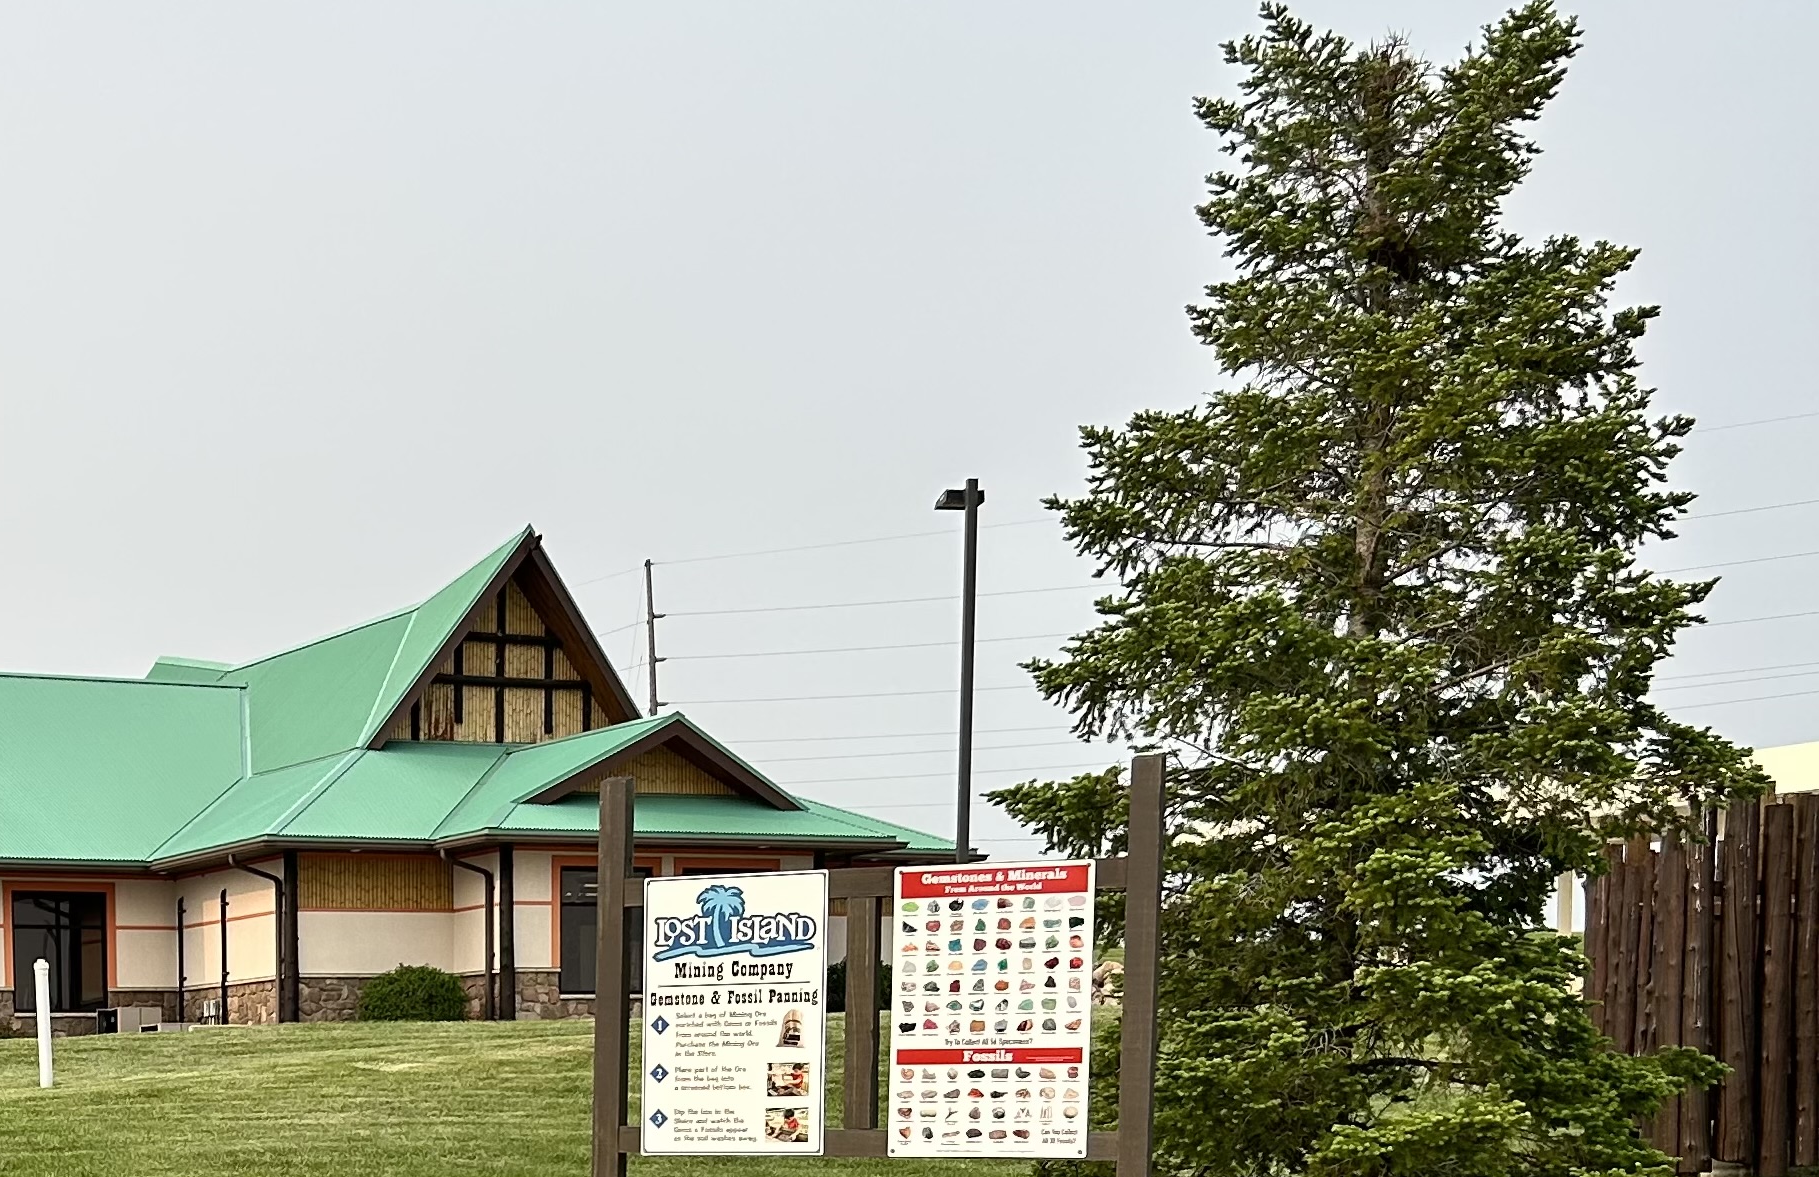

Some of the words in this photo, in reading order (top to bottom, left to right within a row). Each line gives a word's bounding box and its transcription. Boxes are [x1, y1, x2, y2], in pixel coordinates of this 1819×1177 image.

[922, 873, 992, 884] Gemstones
[995, 871, 1004, 881] &
[1008, 868, 1067, 881] Minerals
[968, 884, 999, 892] Around
[1016, 882, 1042, 890] World
[675, 961, 724, 981] Mining
[732, 961, 793, 980] Company
[651, 992, 705, 1006] Gemstone
[711, 991, 721, 1004] &
[728, 989, 762, 1004] Fossil
[769, 988, 818, 1005] Panning
[658, 1020, 662, 1031] 1
[963, 1050, 1013, 1062] Fossils
[656, 1068, 662, 1079] 2
[655, 1113, 662, 1124] 3
